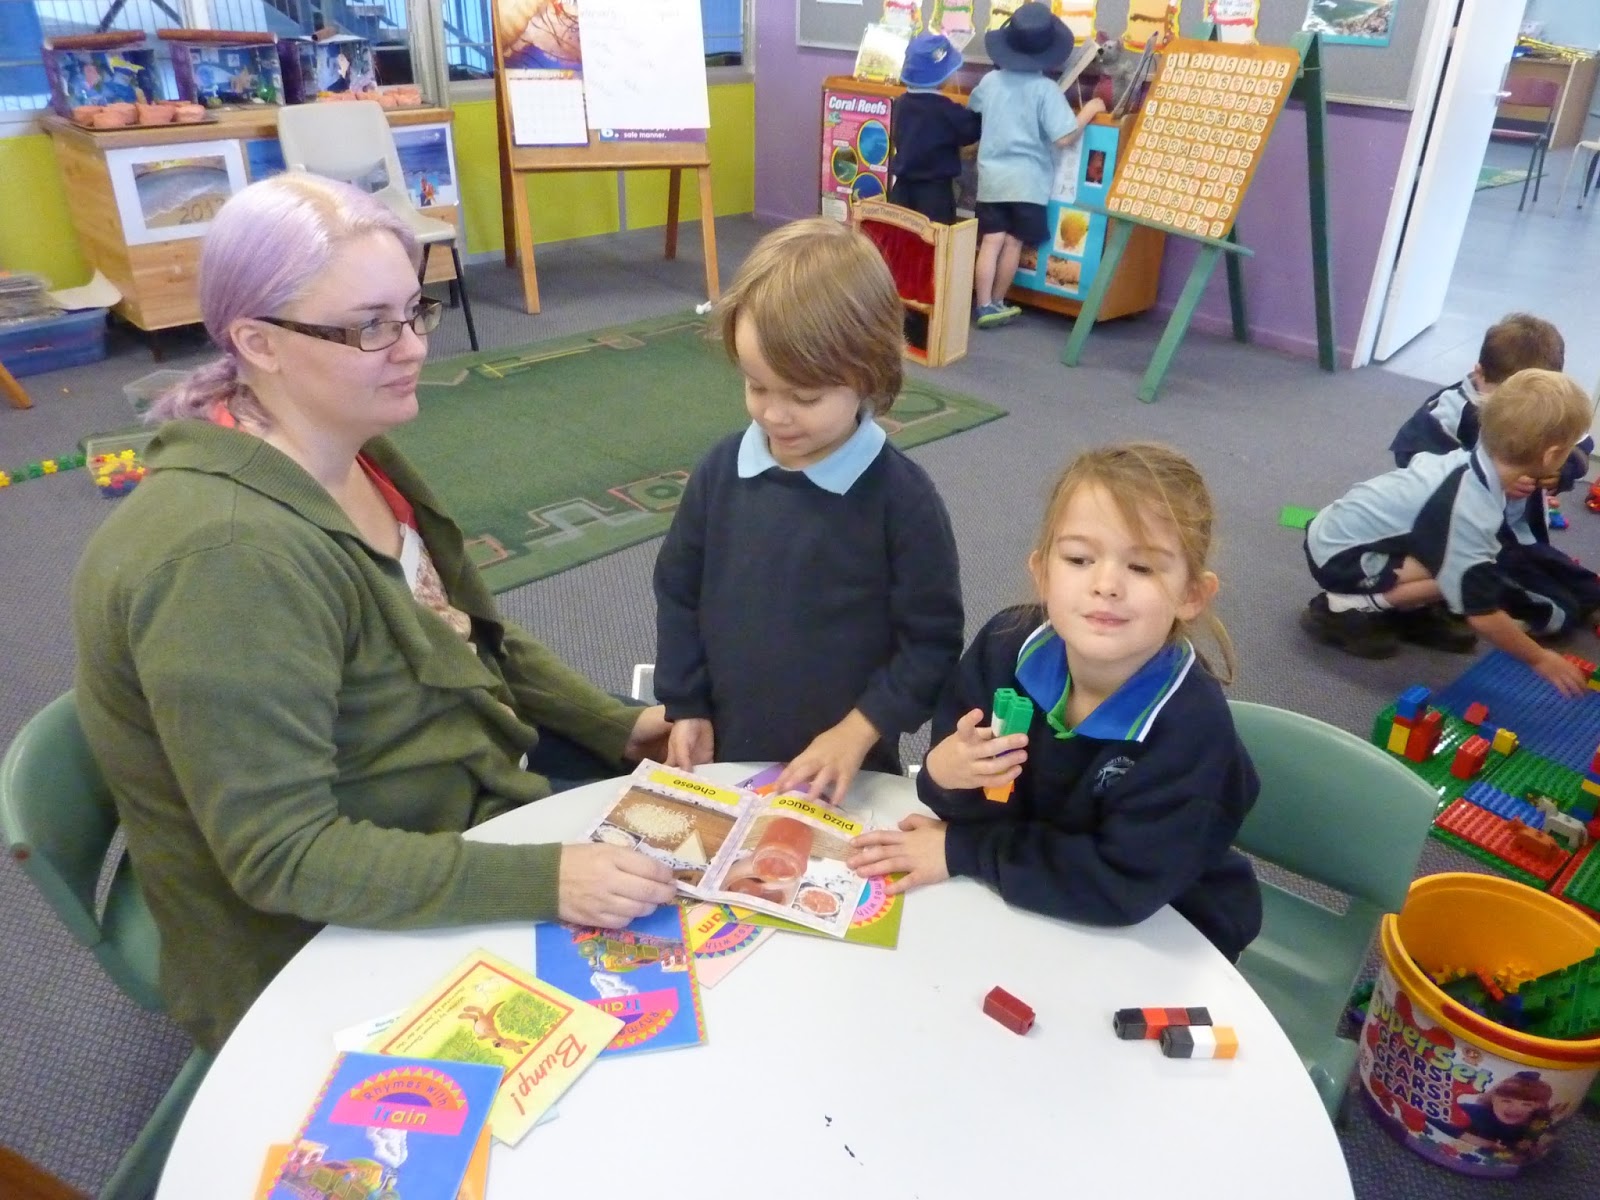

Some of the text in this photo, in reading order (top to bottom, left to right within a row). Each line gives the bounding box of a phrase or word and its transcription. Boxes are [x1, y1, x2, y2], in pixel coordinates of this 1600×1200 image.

[829, 96, 887, 115] Coral Reefs
[624, 131, 638, 139] safe
[672, 778, 717, 797] cheese
[778, 797, 855, 832] pizza sauce
[619, 1011, 660, 1036] Rhyme
[1378, 1023, 1452, 1087] GEARS!
[510, 1033, 587, 1115] Bump!
[1376, 1041, 1451, 1105] GEARS!
[363, 1080, 447, 1106] Rhymes with
[1373, 1061, 1451, 1122] GEARS!
[372, 1105, 427, 1125] Train
